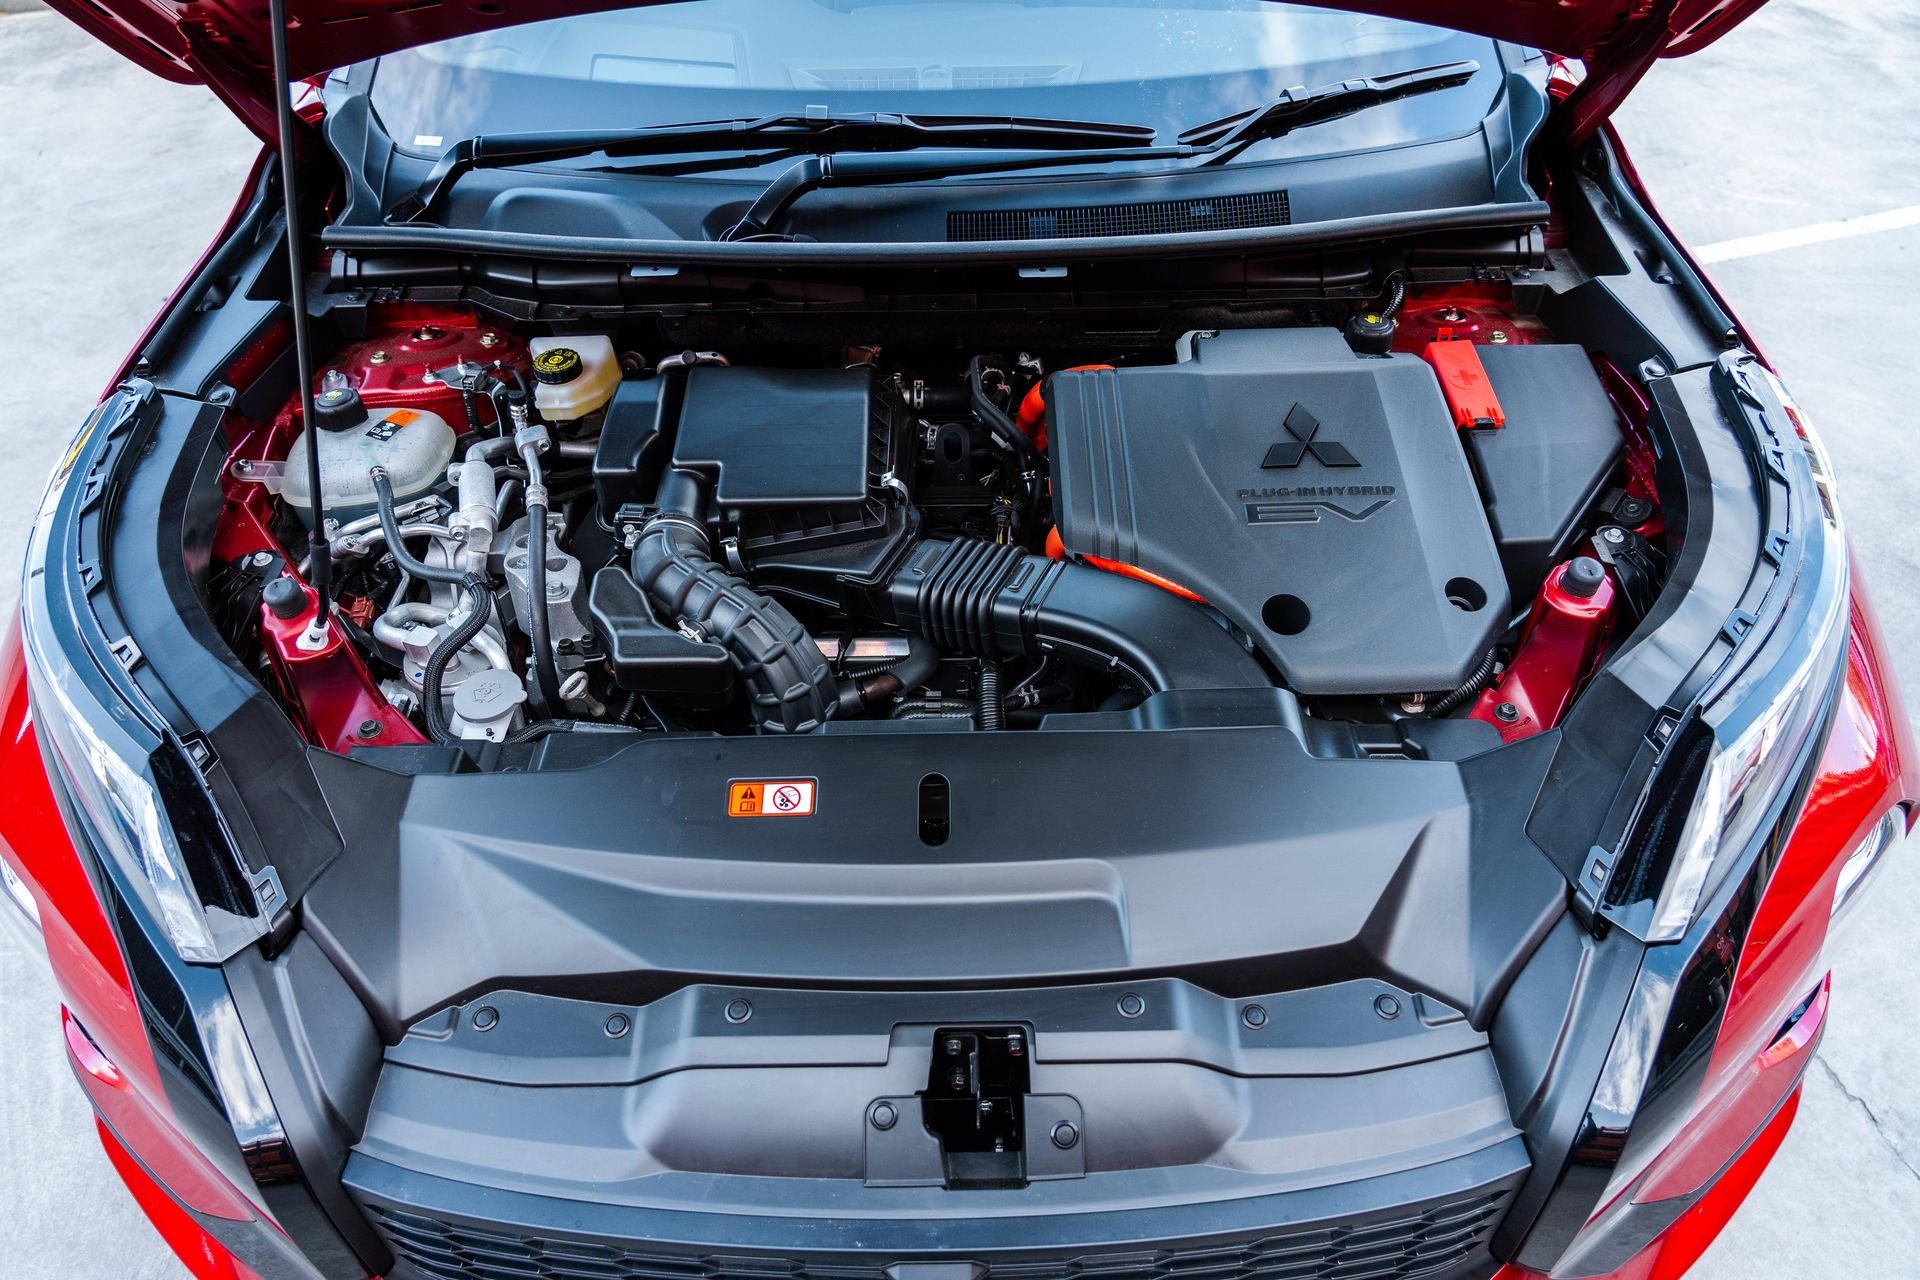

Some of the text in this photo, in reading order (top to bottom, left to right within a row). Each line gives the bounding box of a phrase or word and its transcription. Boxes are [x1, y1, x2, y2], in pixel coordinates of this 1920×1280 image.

[1237, 485, 1395, 498] PLUG-IN HYBRID
[1244, 499, 1396, 525] EV
